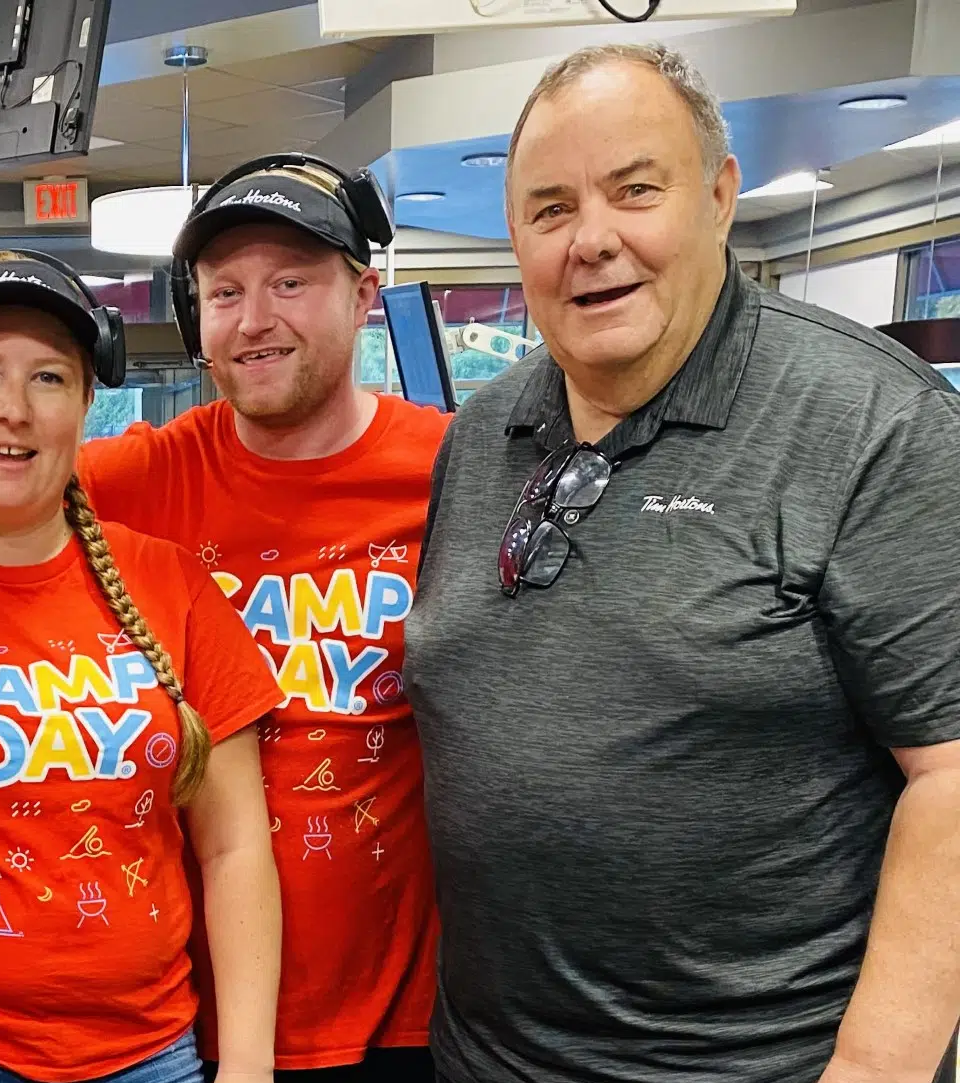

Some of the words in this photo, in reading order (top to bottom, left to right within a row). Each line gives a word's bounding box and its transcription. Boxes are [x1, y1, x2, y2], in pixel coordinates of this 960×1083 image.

[35, 183, 78, 219] EXIT
[242, 188, 302, 213] Hortons
[640, 495, 667, 513] Tim
[664, 494, 715, 515] Hortons
[210, 568, 414, 645] AMP
